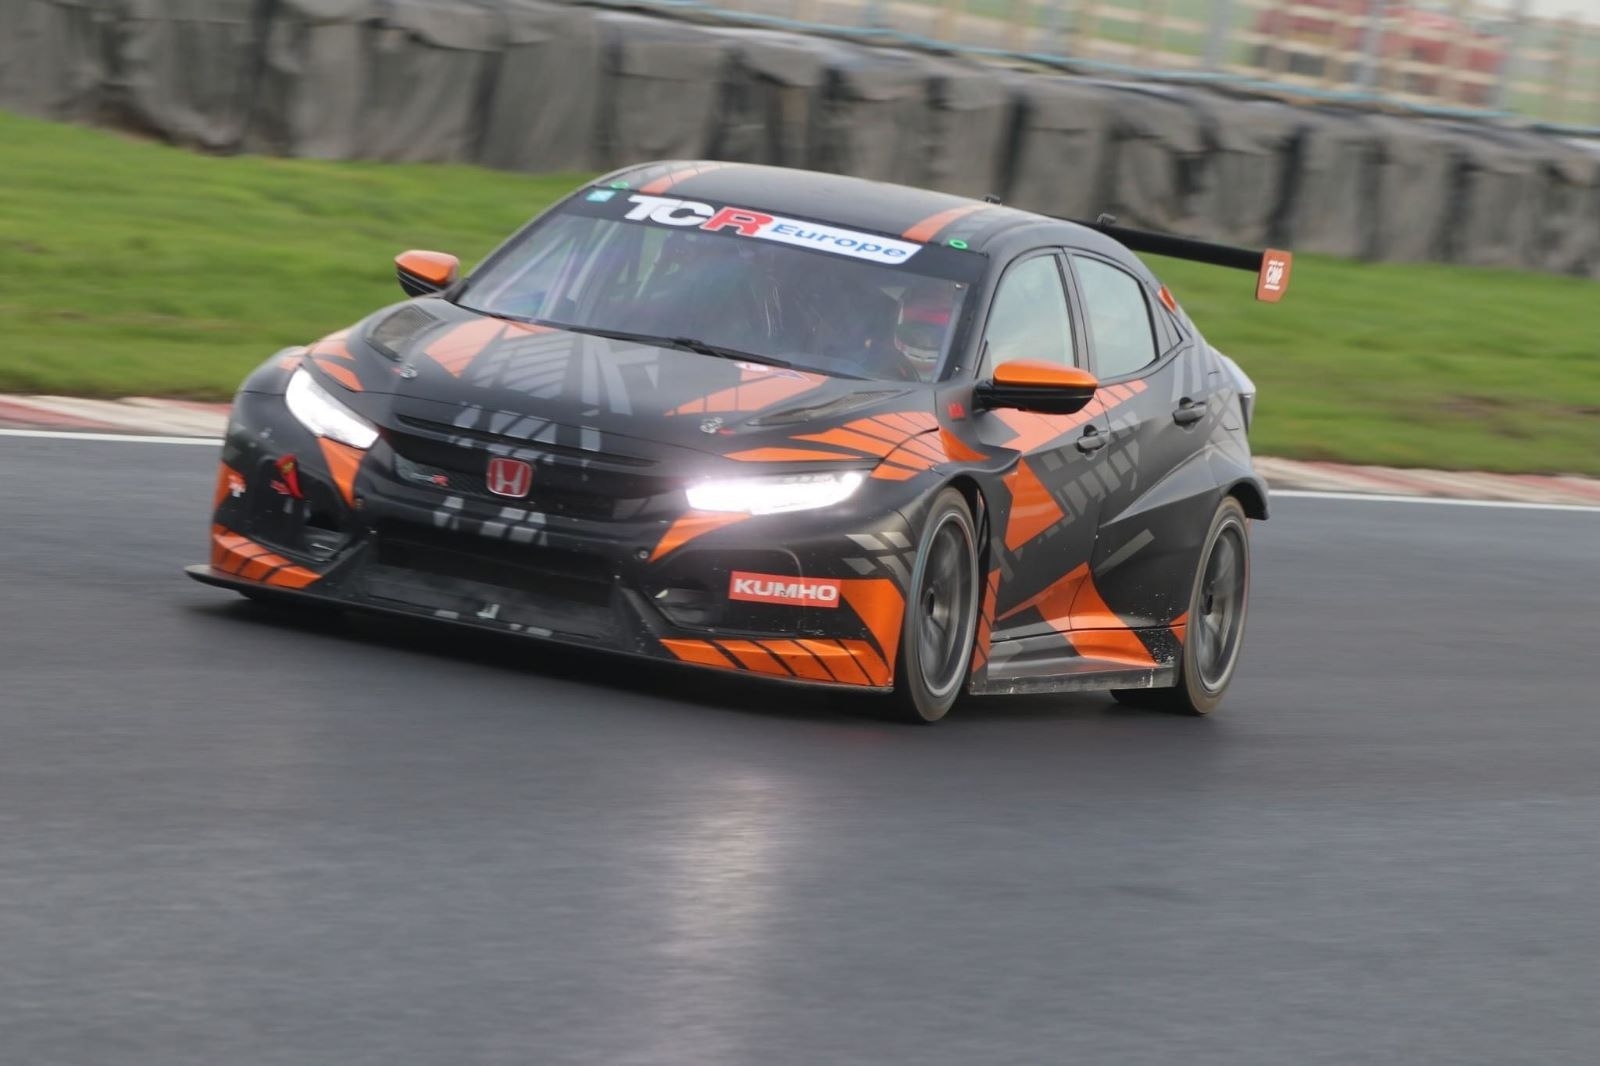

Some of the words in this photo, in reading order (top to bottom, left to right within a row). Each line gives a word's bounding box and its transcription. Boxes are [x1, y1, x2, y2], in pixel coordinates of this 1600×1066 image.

[624, 195, 775, 236] TCR
[770, 224, 907, 258] Europe
[733, 578, 838, 601] KUMHO
